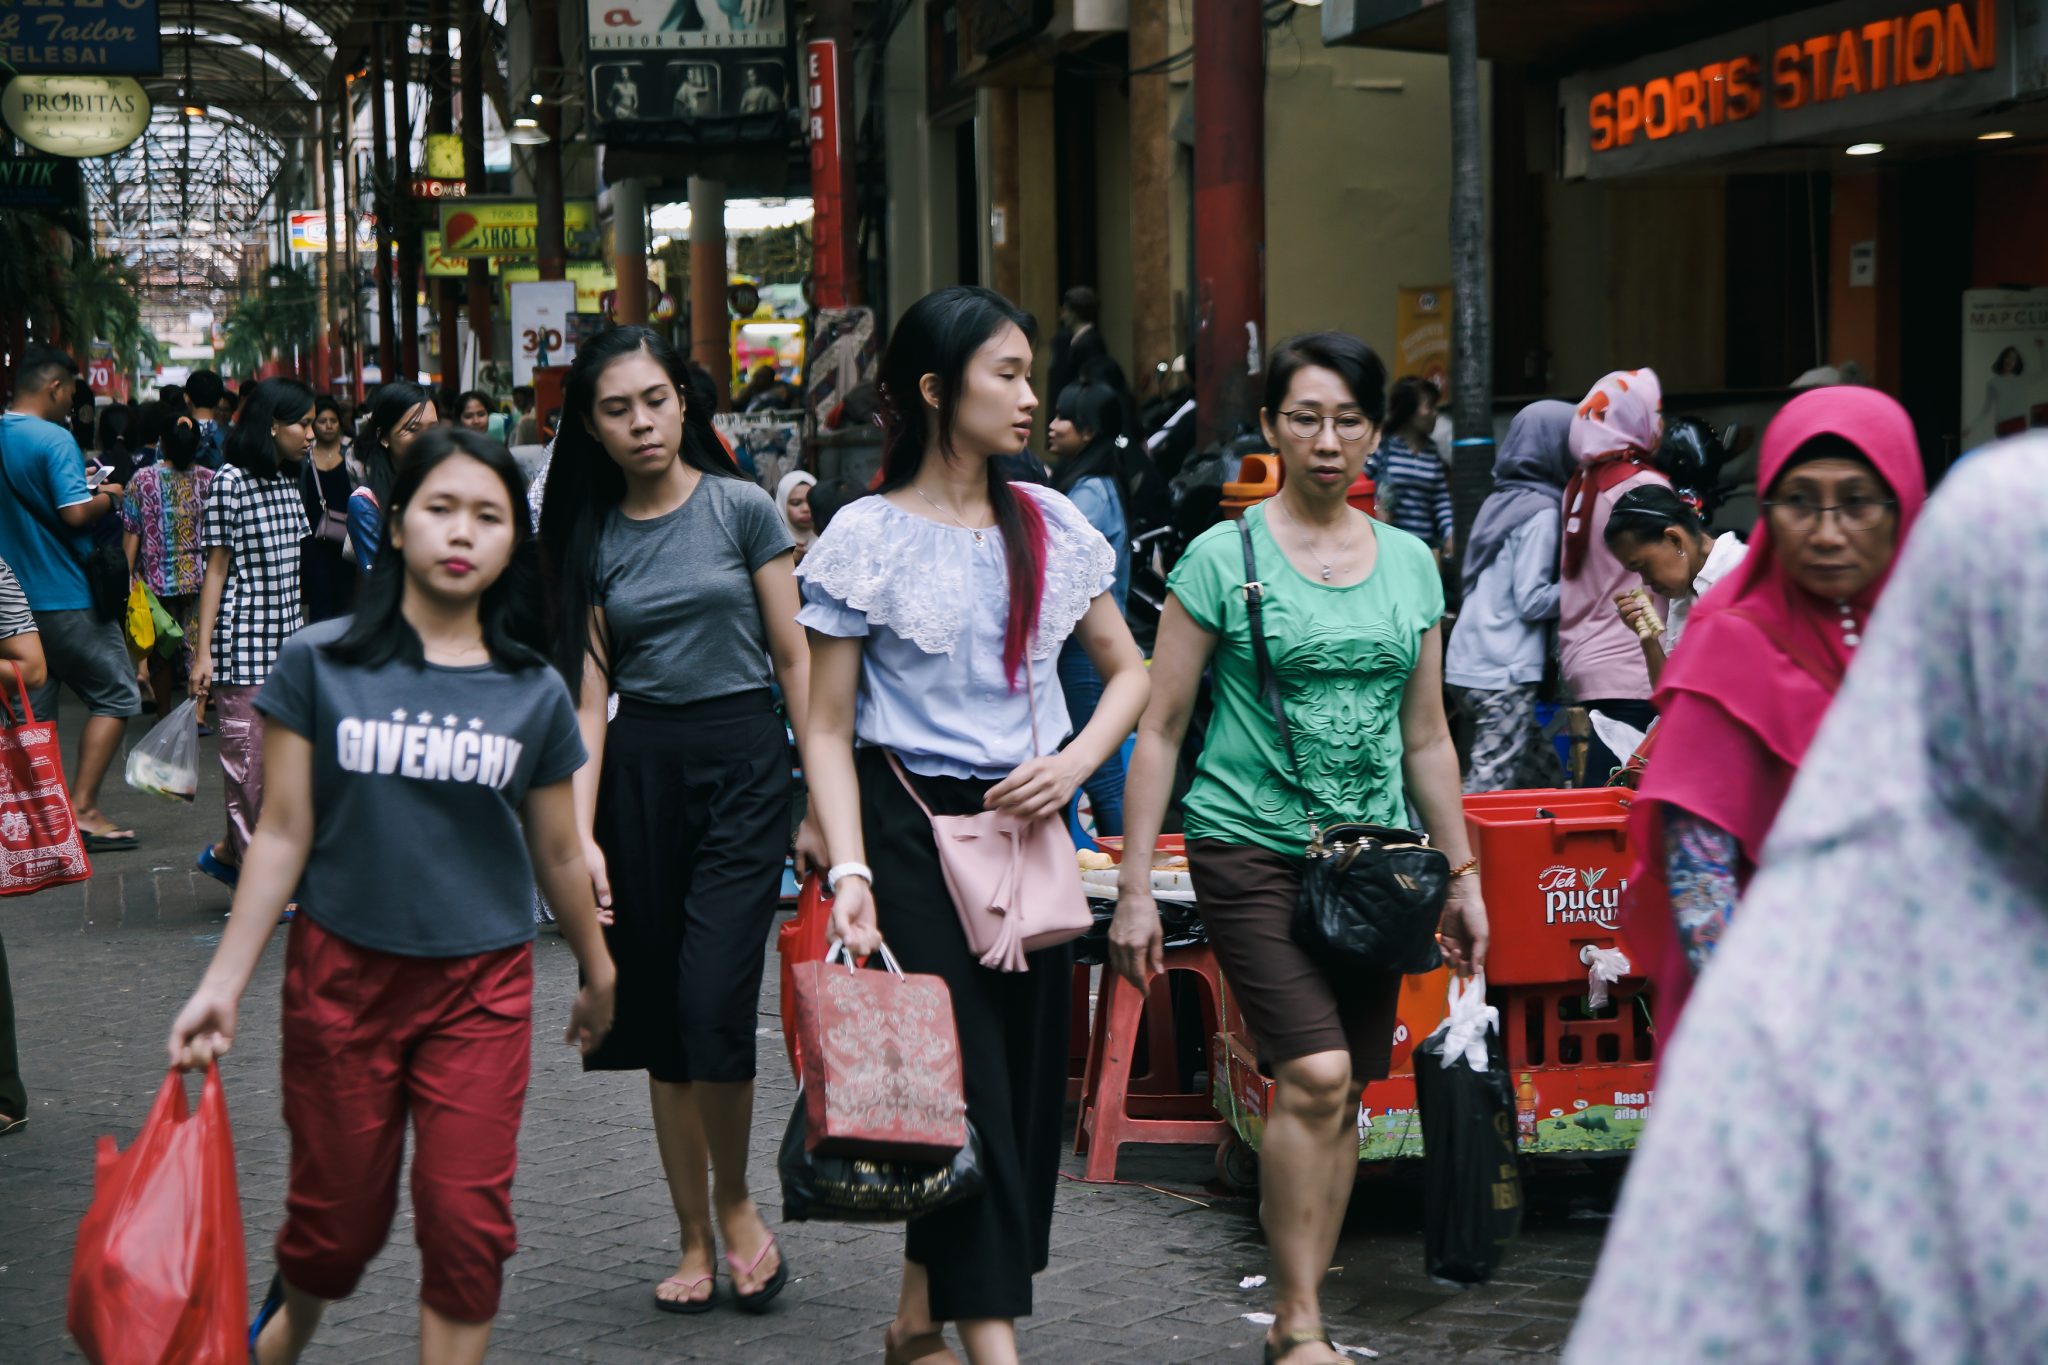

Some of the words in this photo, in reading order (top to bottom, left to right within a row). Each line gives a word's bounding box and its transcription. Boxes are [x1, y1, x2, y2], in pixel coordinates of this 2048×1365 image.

[36, 14, 136, 41] Tailor
[590, 35, 664, 47] TAILOR
[1589, 56, 1761, 151] SPORTS
[1773, 0, 1996, 110] STATION
[22, 93, 135, 113] PROBITAS
[483, 227, 518, 249] SHOE
[88, 367, 108, 386] 70
[337, 717, 523, 790] GIVENCHY
[1538, 868, 1576, 890] Teh
[1562, 908, 1621, 930] HARU
[1614, 1091, 1645, 1105] Rasa
[1614, 1108, 1637, 1120] ada
